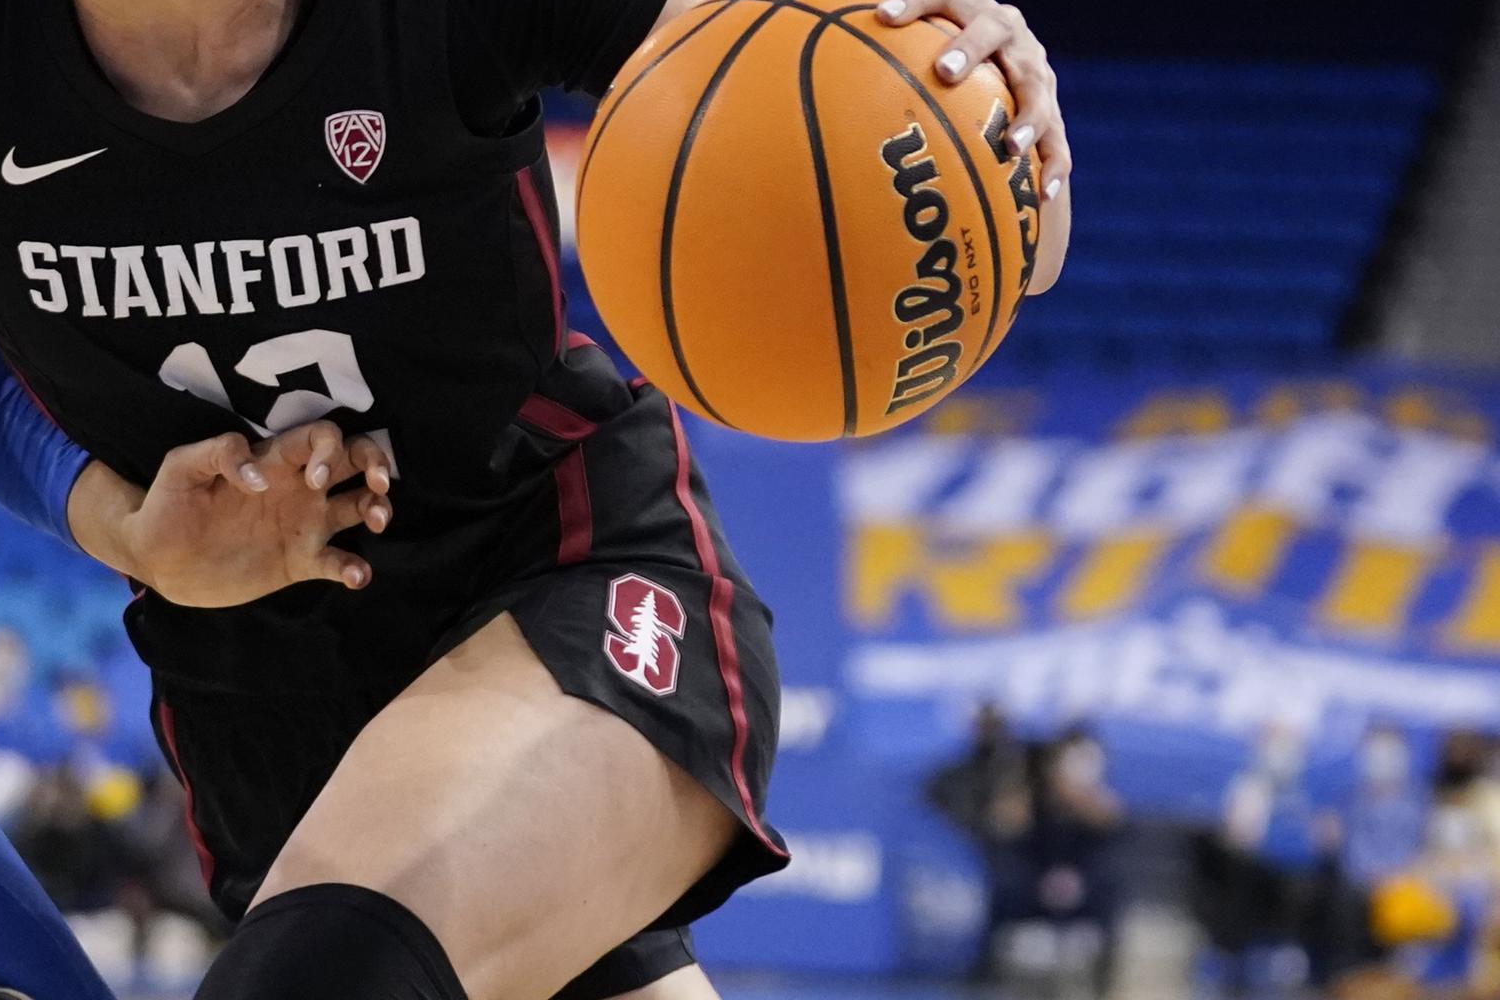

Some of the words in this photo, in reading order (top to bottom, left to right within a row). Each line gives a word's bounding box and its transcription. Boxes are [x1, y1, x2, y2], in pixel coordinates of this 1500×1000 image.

[328, 113, 381, 157] PAC
[344, 140, 373, 168] 12
[17, 216, 427, 320] STANFORD
[878, 122, 966, 416] Wilson
